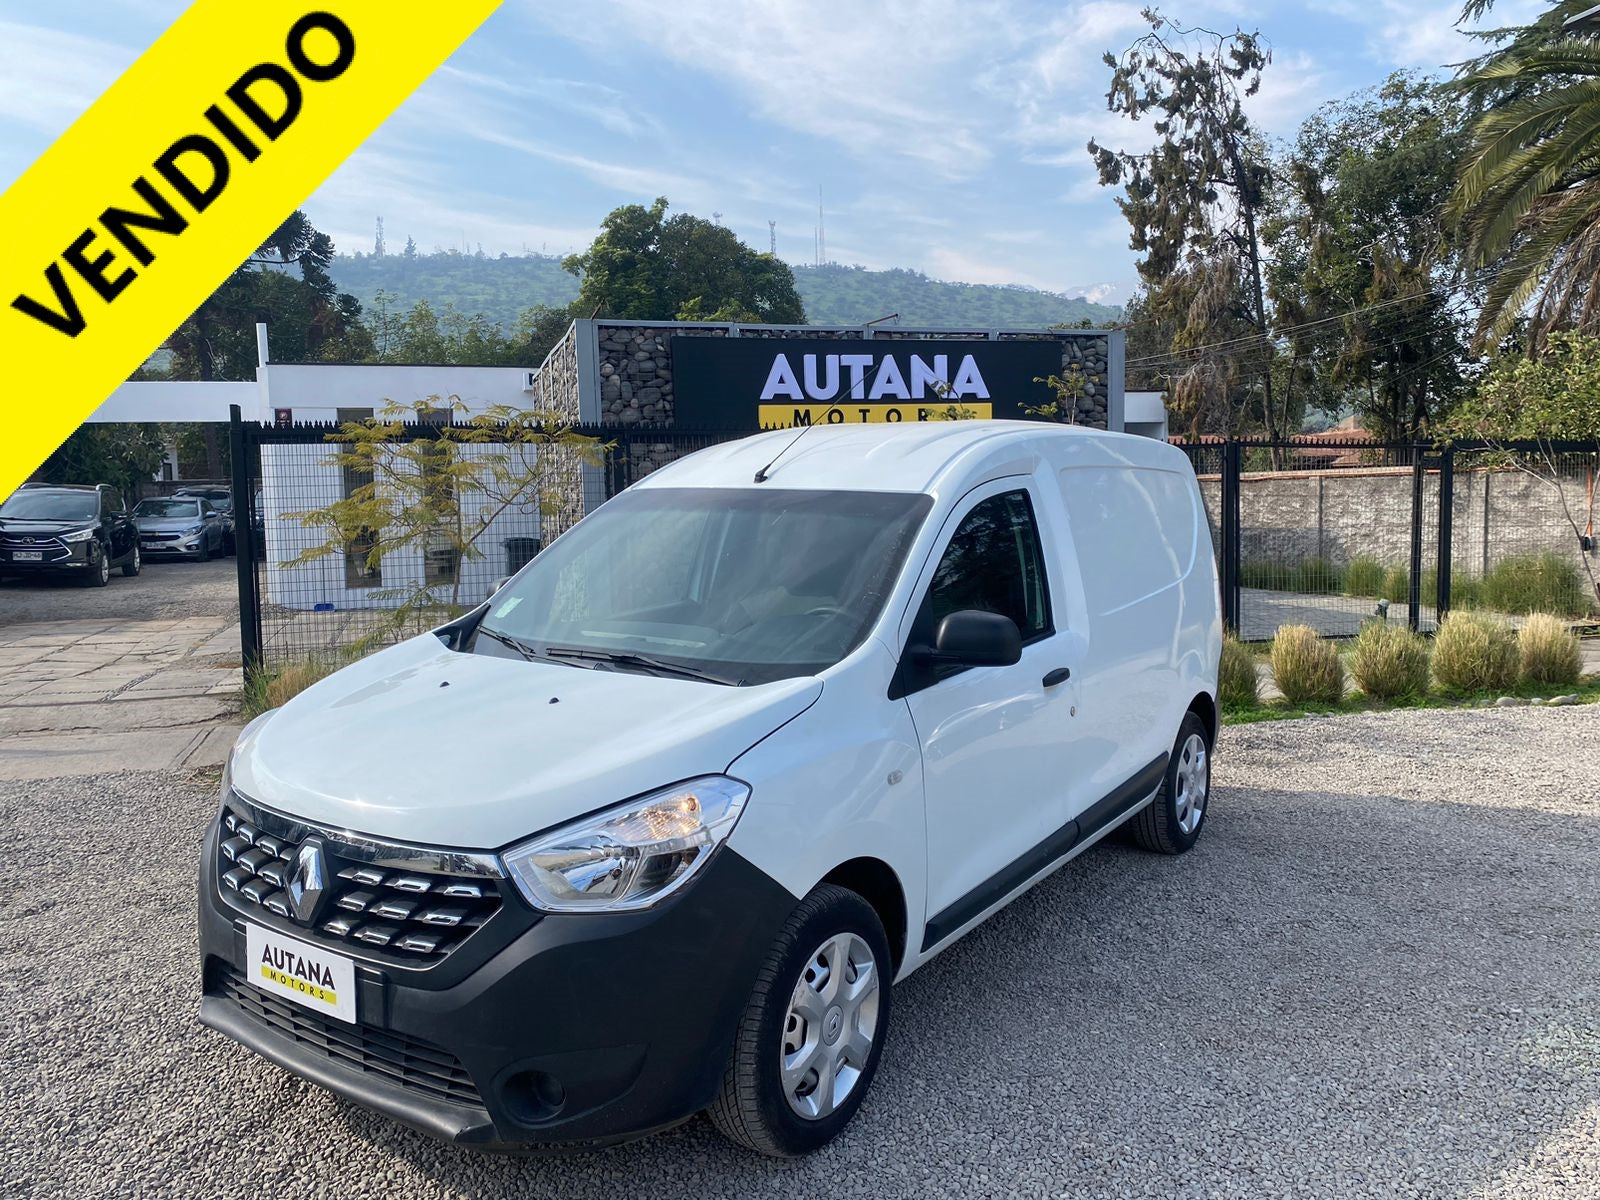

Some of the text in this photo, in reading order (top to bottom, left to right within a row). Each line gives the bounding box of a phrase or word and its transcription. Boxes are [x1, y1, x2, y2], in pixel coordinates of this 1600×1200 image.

[760, 353, 990, 400] AUTANA
[261, 943, 335, 991] AUTANA
[269, 970, 325, 1000] MOTORS
